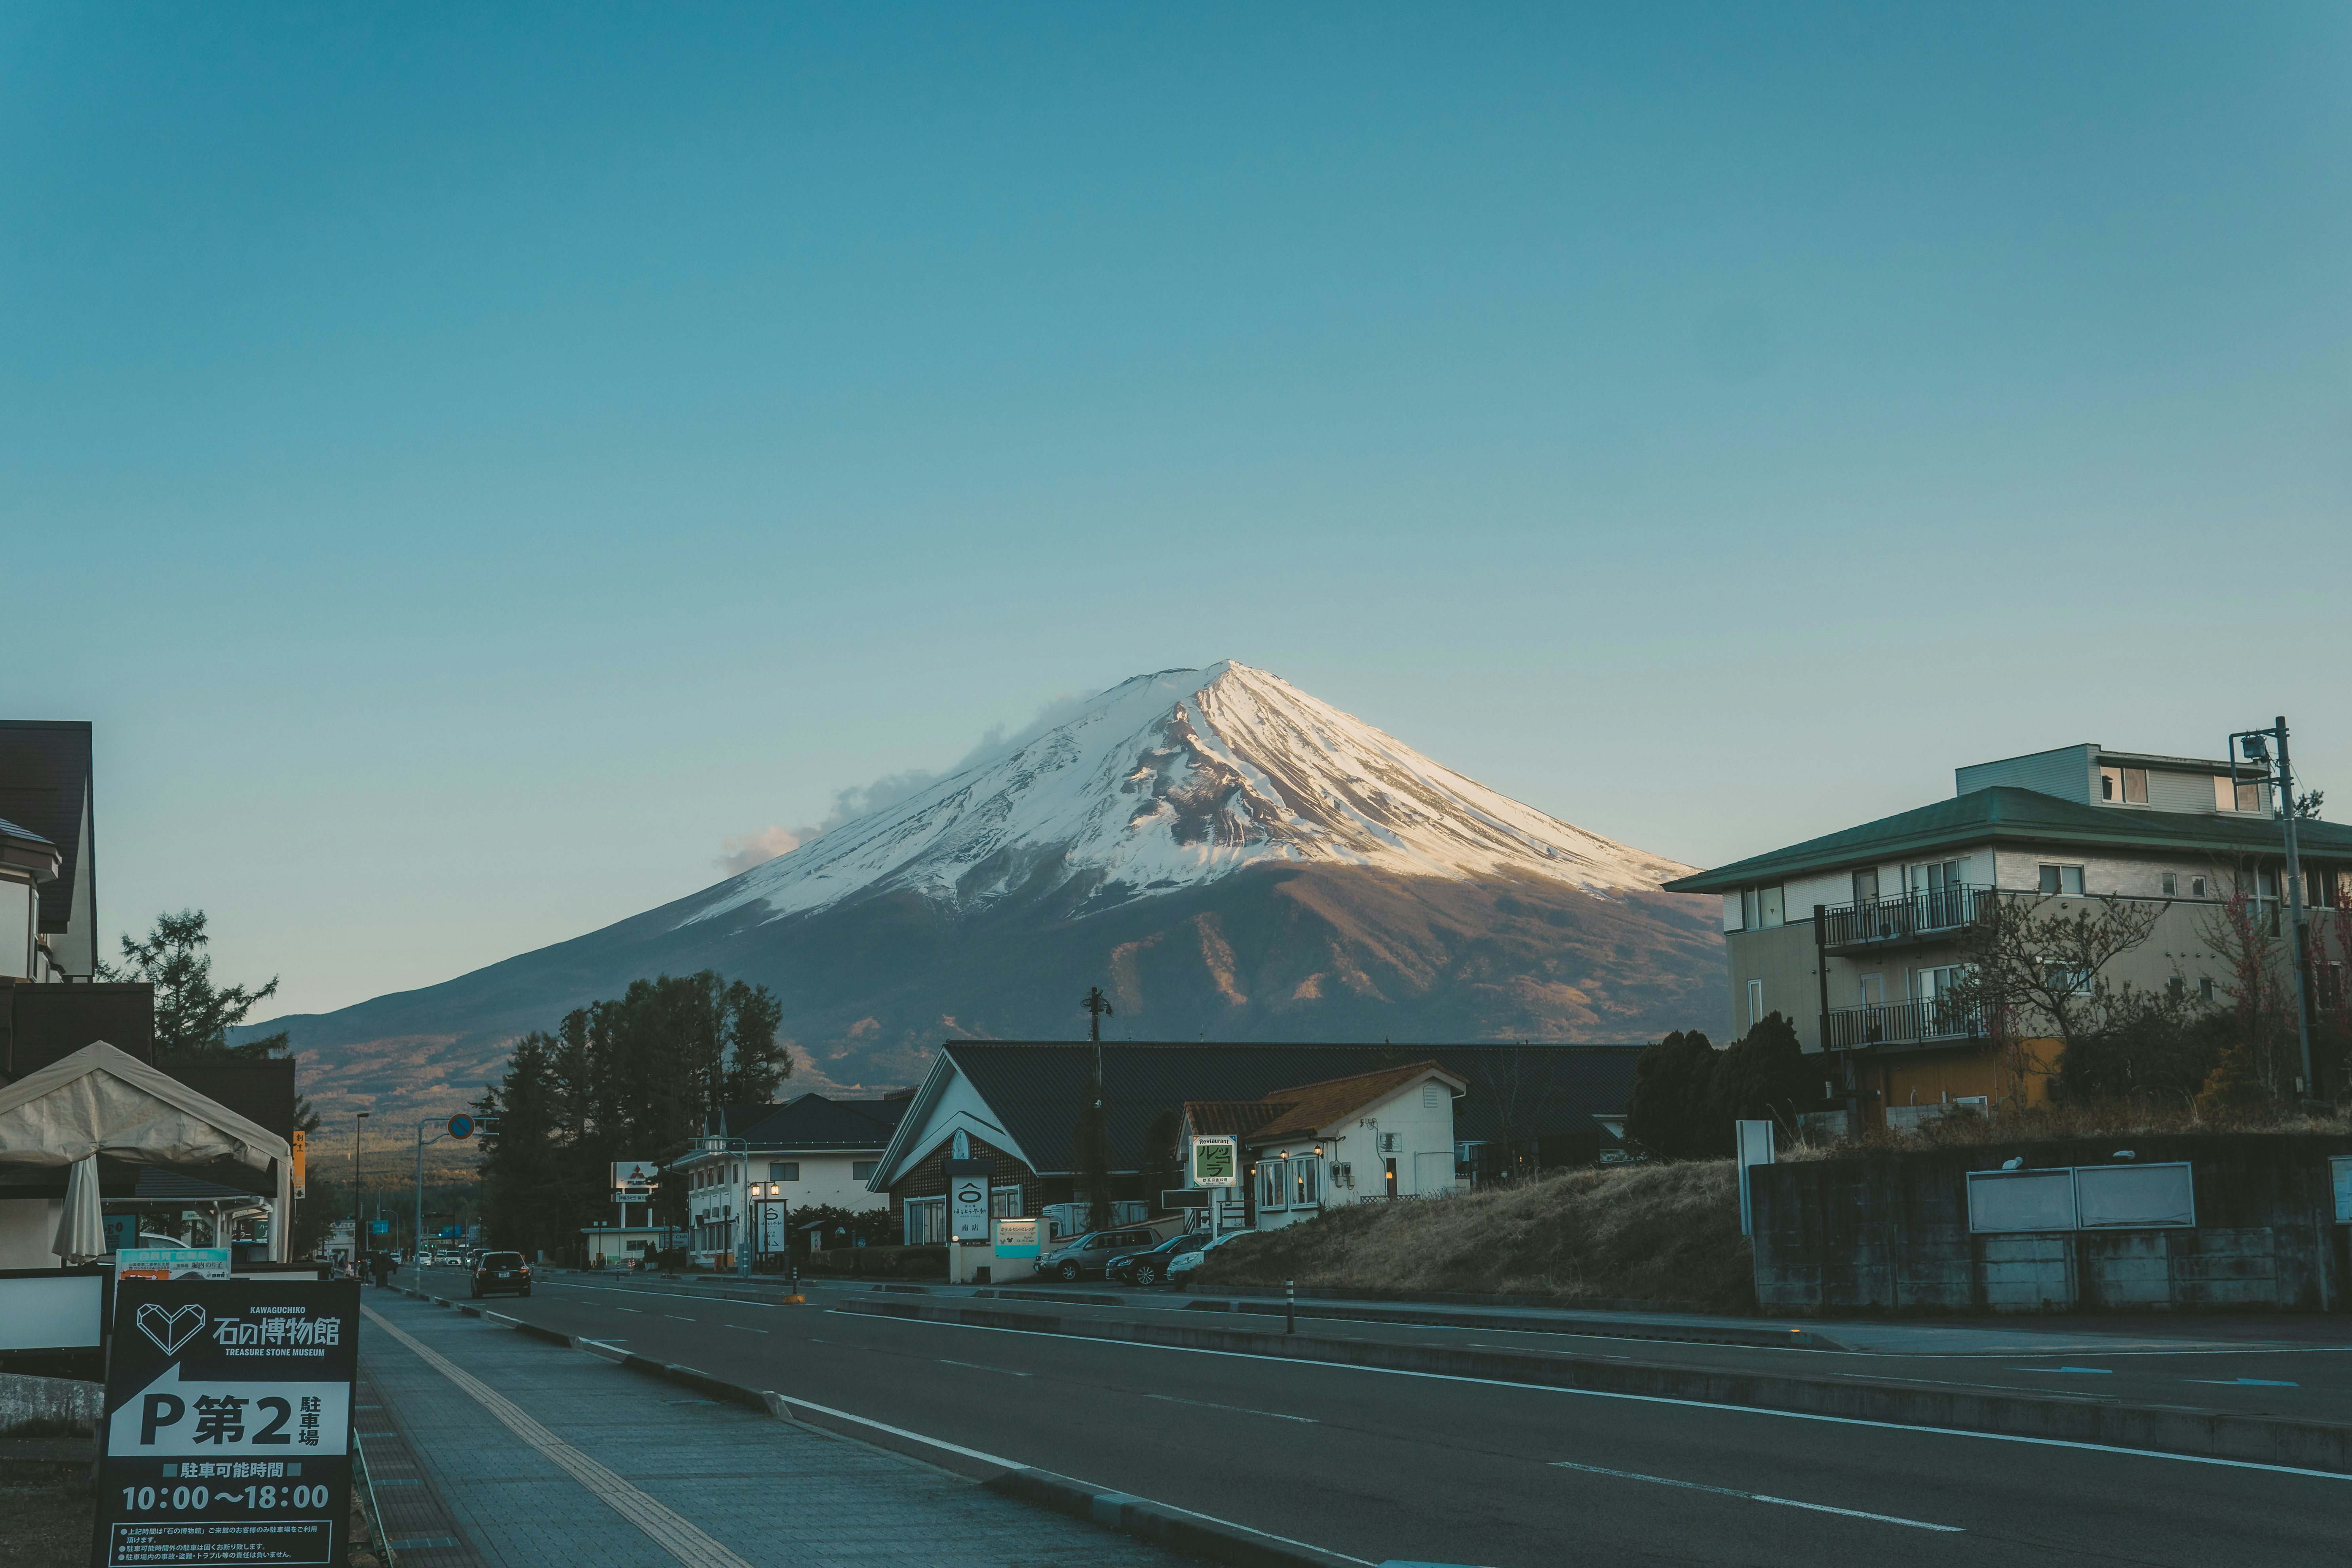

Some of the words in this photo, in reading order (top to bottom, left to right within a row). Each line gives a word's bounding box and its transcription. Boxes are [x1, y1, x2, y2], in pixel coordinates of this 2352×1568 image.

[1198, 1146, 1230, 1176] ルッコラ
[213, 1317, 340, 1345] 石の博物館
[140, 1393, 185, 1445] P
[299, 1396, 321, 1446] 駐車場
[181, 1462, 284, 1478] 駐車可能時間
[126, 1543, 265, 1552] 駐車可能時間外の駐車は固くお断り致します。
